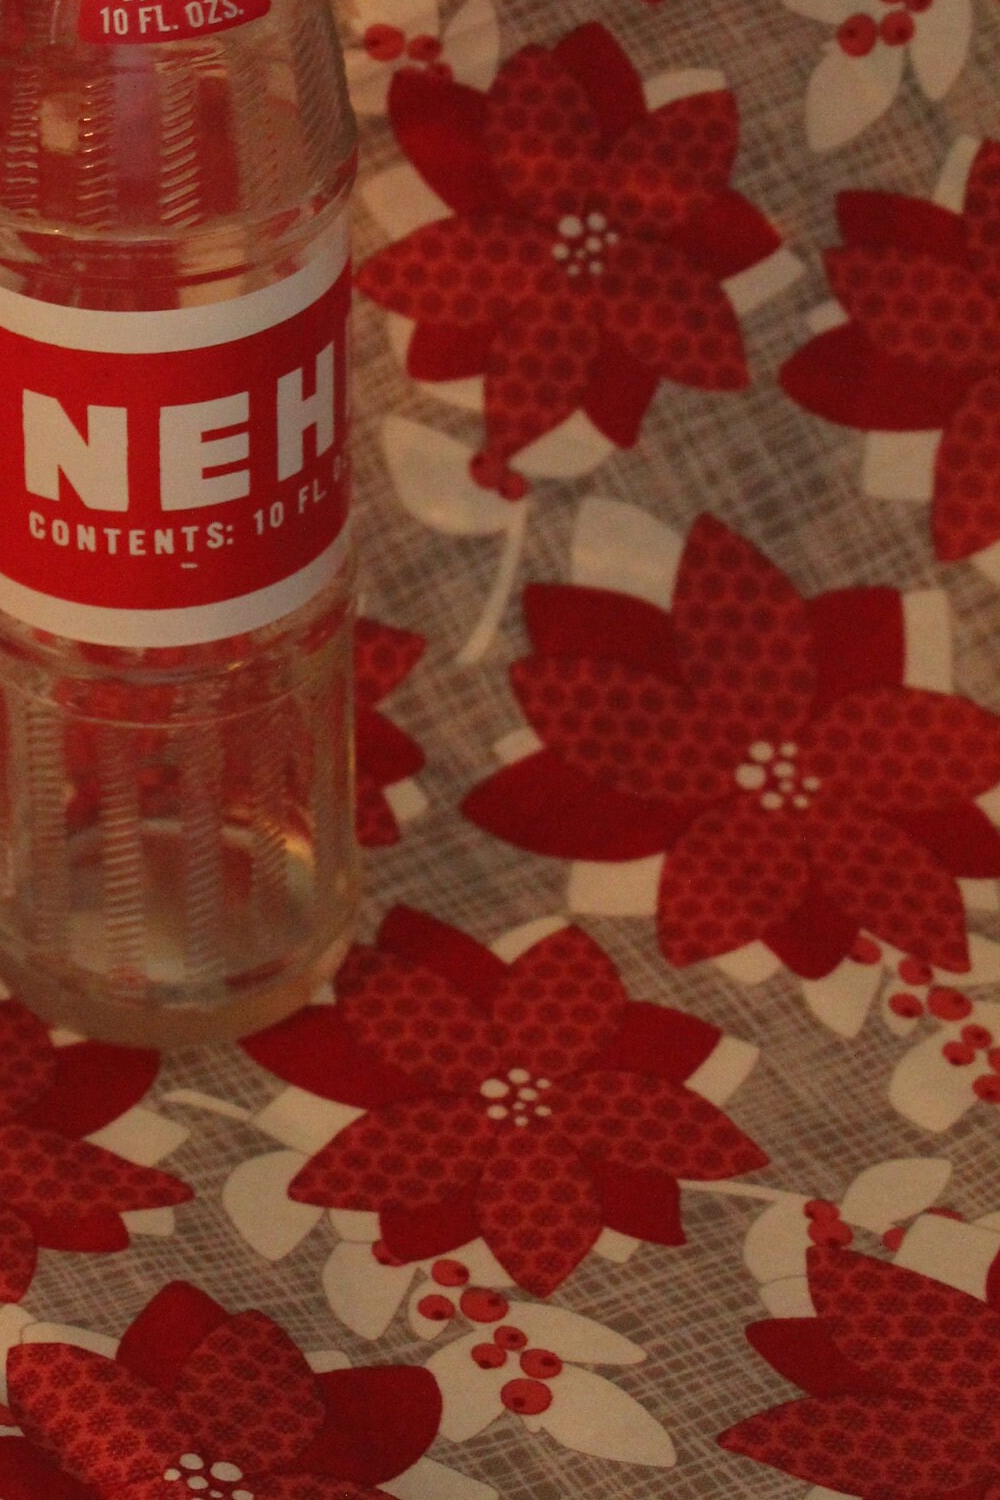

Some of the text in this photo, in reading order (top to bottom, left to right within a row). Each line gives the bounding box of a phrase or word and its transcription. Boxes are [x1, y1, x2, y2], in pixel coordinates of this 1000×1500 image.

[100, 7, 129, 35] 10
[139, 5, 179, 34] FL.
[29, 510, 234, 556] CONTENTS:
[253, 501, 284, 535] 10
